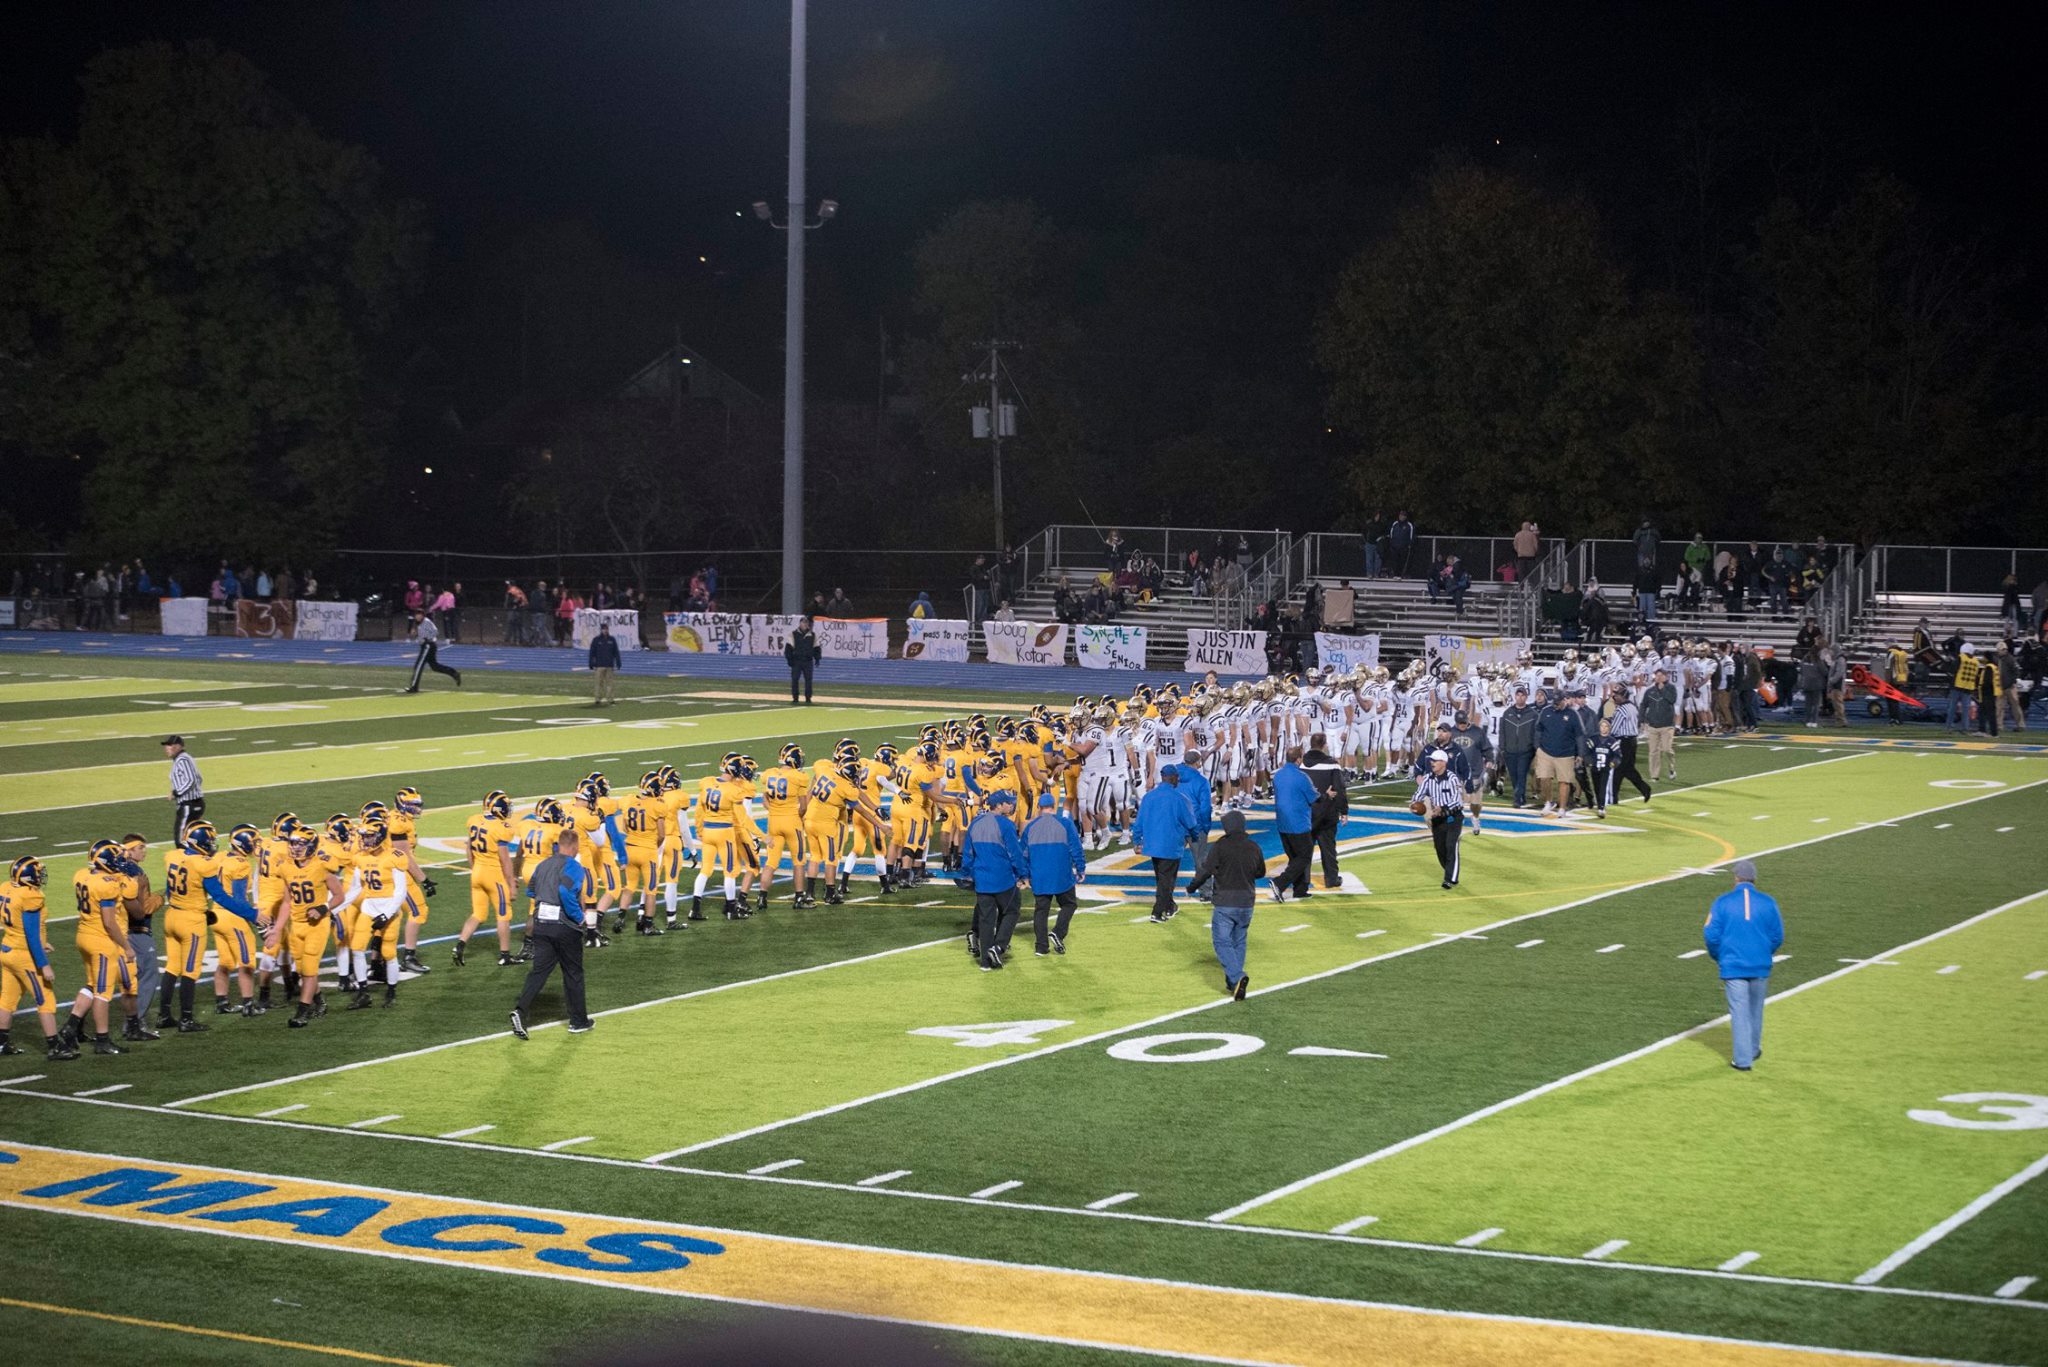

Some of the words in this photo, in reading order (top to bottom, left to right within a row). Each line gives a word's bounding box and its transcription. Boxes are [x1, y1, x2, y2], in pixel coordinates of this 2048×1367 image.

[708, 625, 745, 642] LEMUS
[767, 635, 784, 650] RB
[922, 630, 941, 641] pass
[942, 629, 952, 640] to
[954, 631, 968, 641] me
[992, 623, 1027, 646] Doug
[1081, 626, 1142, 644] SANCHEZ
[1197, 630, 1256, 649] JUSTIN
[1323, 634, 1373, 652] Senior
[1439, 634, 1461, 650] Big
[1015, 647, 1053, 665] Kotar
[1103, 645, 1144, 671] SENIOR
[1196, 648, 1233, 666] ALLEN
[1324, 648, 1348, 663] Josh
[1107, 748, 1117, 767] 1
[766, 776, 789, 801] 59
[811, 775, 837, 803] 55
[896, 766, 912, 790] 61
[705, 787, 722, 813] 19
[627, 806, 647, 833] 81
[469, 825, 488, 853] 25
[524, 829, 545, 855] 41
[167, 863, 188, 896] 53
[363, 869, 383, 891] 16
[19, 1167, 727, 1273] MACS
